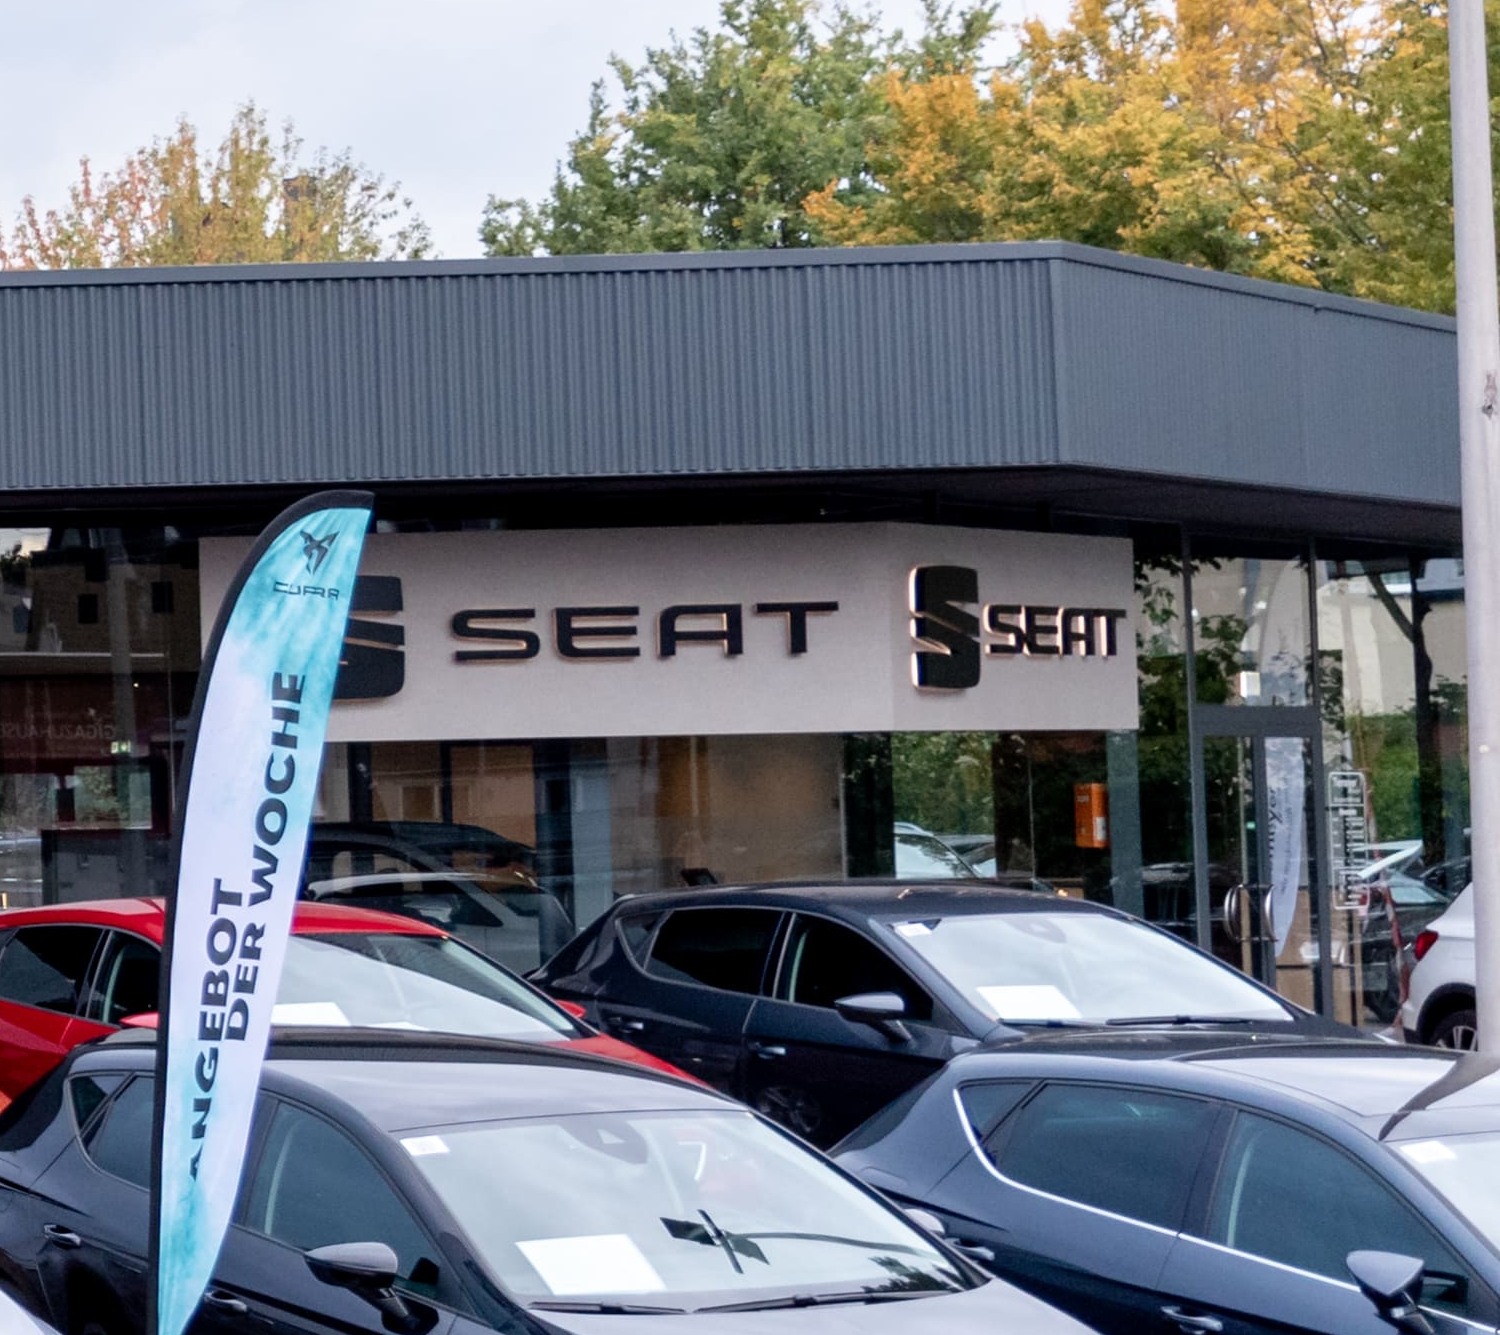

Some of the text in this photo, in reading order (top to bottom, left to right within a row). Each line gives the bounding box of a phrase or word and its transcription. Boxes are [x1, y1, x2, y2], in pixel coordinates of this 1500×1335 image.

[451, 601, 839, 662] SEAT
[983, 603, 1127, 656] SEAT
[223, 671, 307, 1042] DER WOCHE
